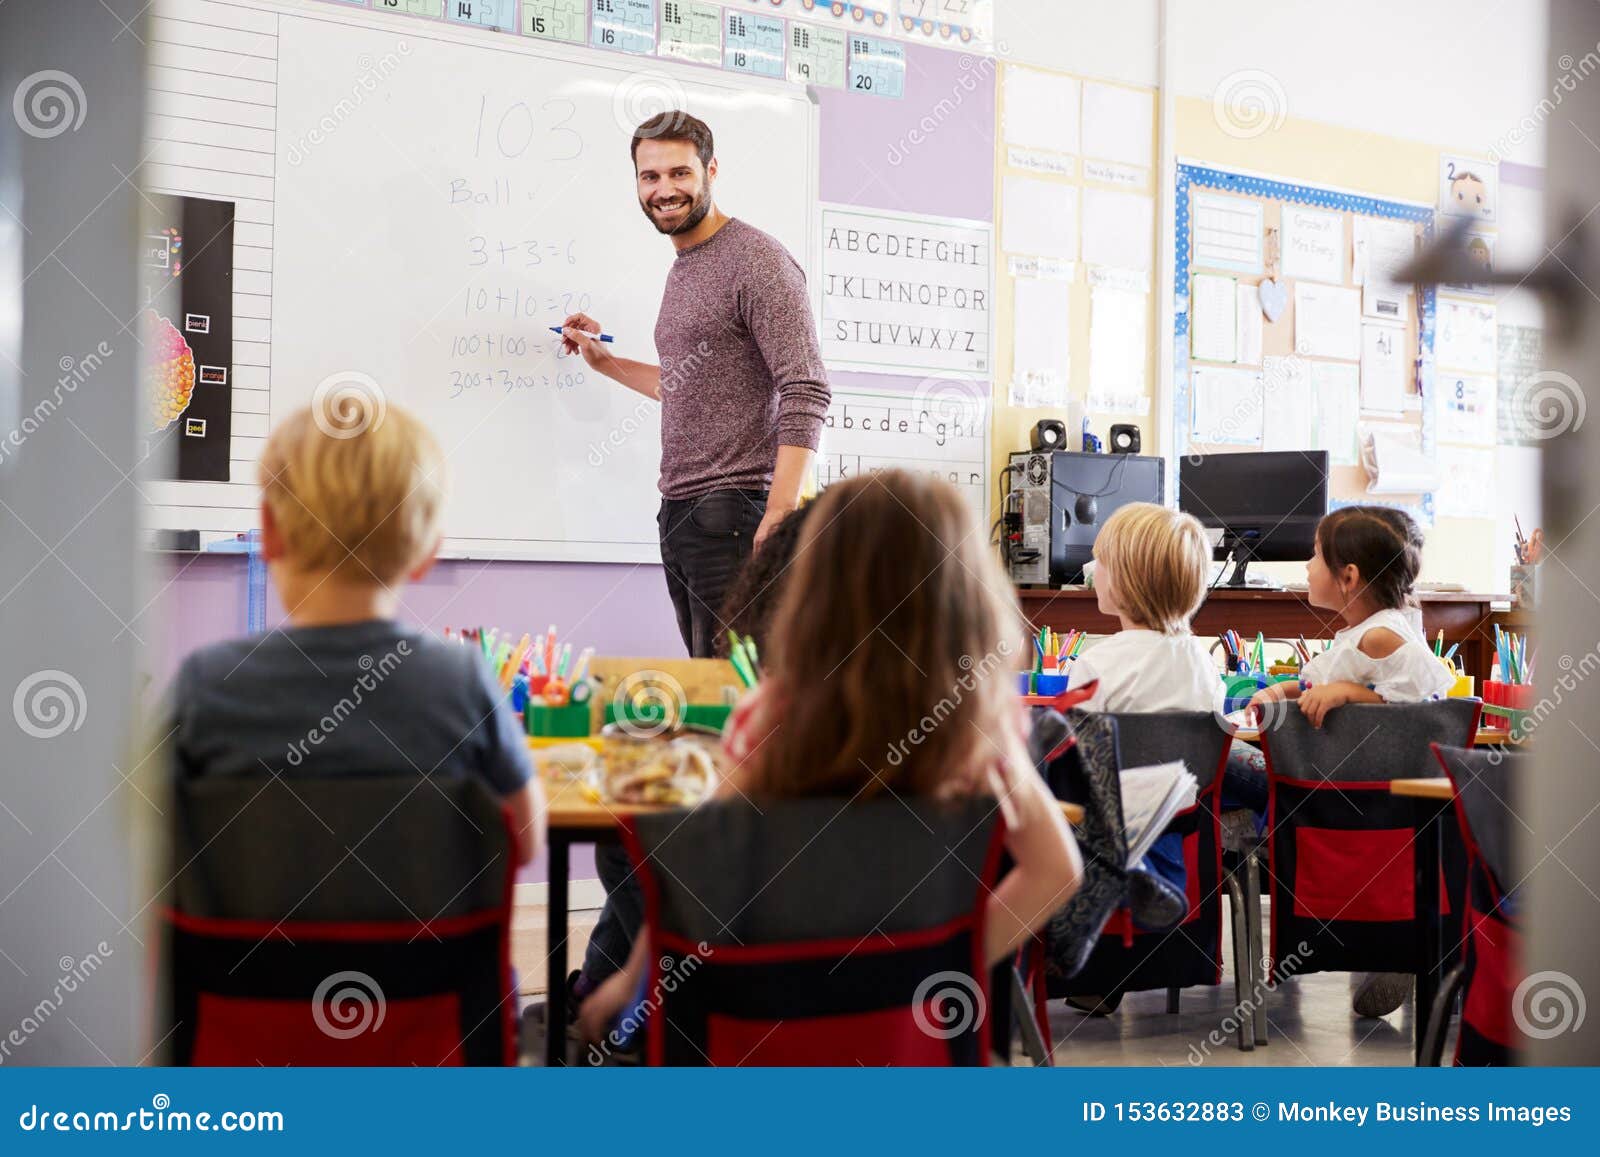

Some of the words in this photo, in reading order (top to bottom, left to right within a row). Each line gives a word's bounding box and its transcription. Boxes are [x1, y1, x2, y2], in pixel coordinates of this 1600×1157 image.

[458, 1, 472, 19] 14
[531, 16, 546, 33] 15
[601, 28, 615, 44] 16
[733, 52, 747, 67] 18
[797, 63, 811, 78] 19
[855, 75, 873, 91] 20
[473, 95, 584, 162] 103
[1447, 162, 1456, 180] 2
[450, 178, 511, 205] Ball
[1455, 380, 1465, 400] 8
